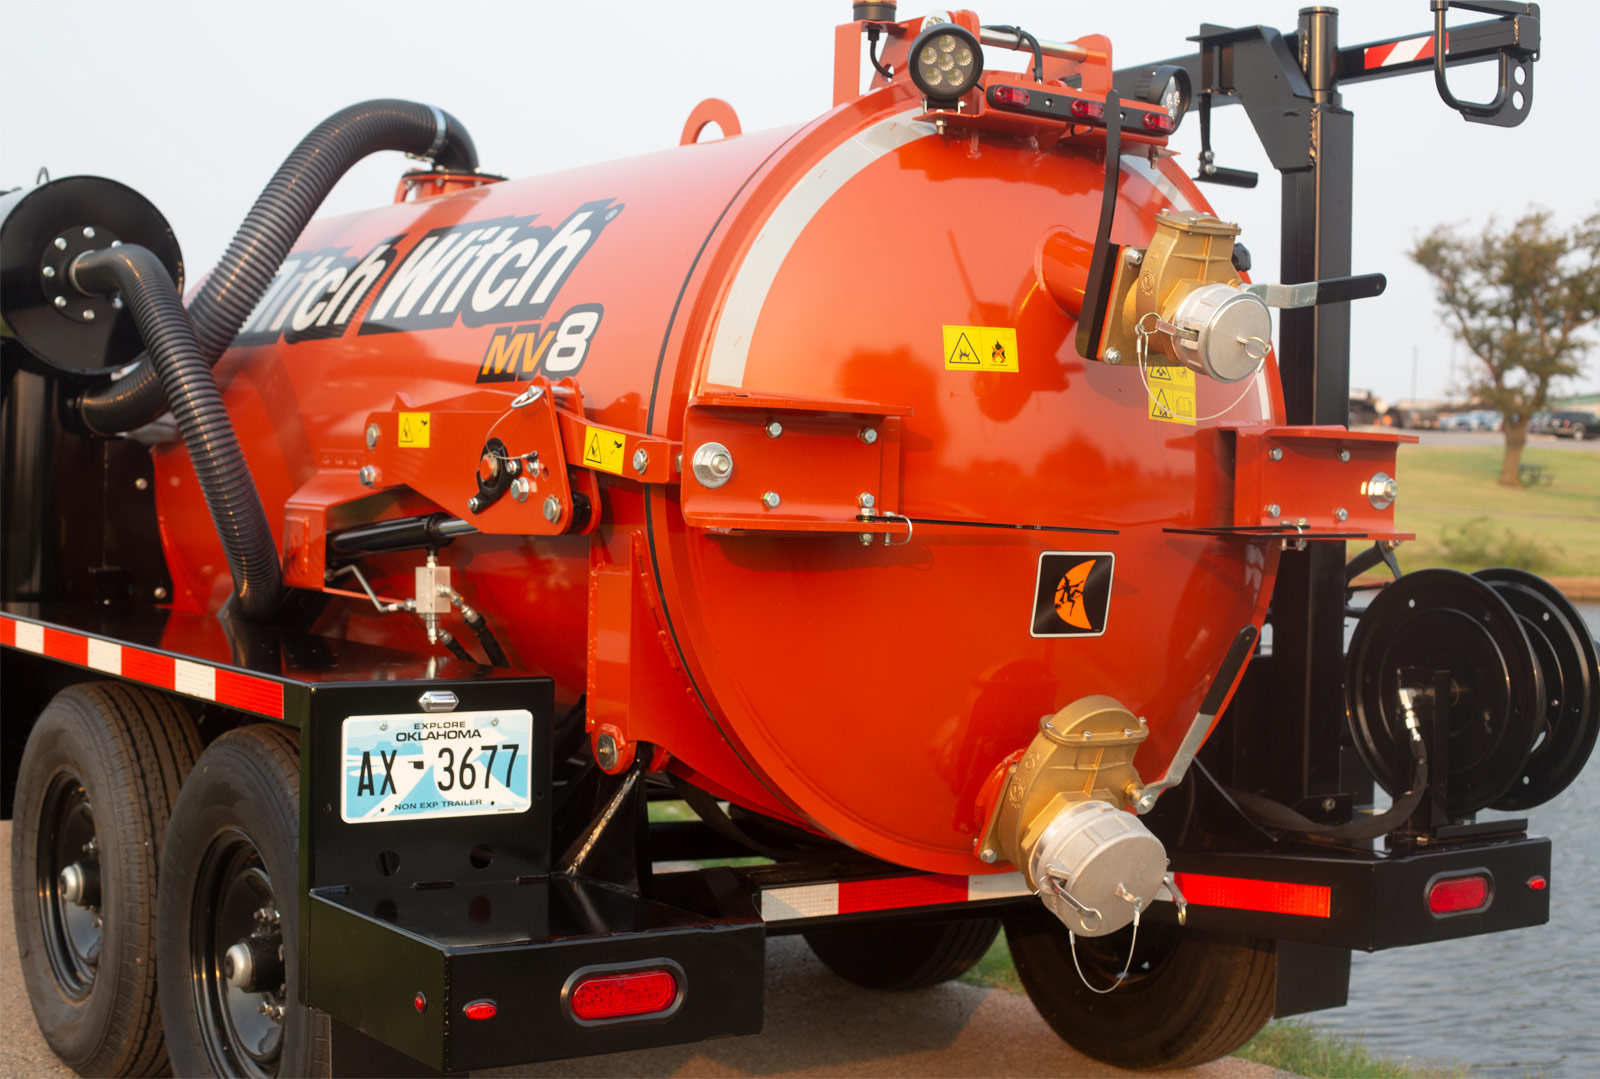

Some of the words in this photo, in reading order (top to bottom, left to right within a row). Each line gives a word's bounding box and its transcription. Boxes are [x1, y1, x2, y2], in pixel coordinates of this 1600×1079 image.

[481, 311, 600, 376] MV8
[414, 721, 466, 730] EXPLORE
[396, 729, 482, 742] OKLAHOMA
[357, 749, 398, 797] AX
[437, 744, 520, 792] 3677
[420, 801, 439, 809] EXP
[441, 799, 483, 808] TRAILER
